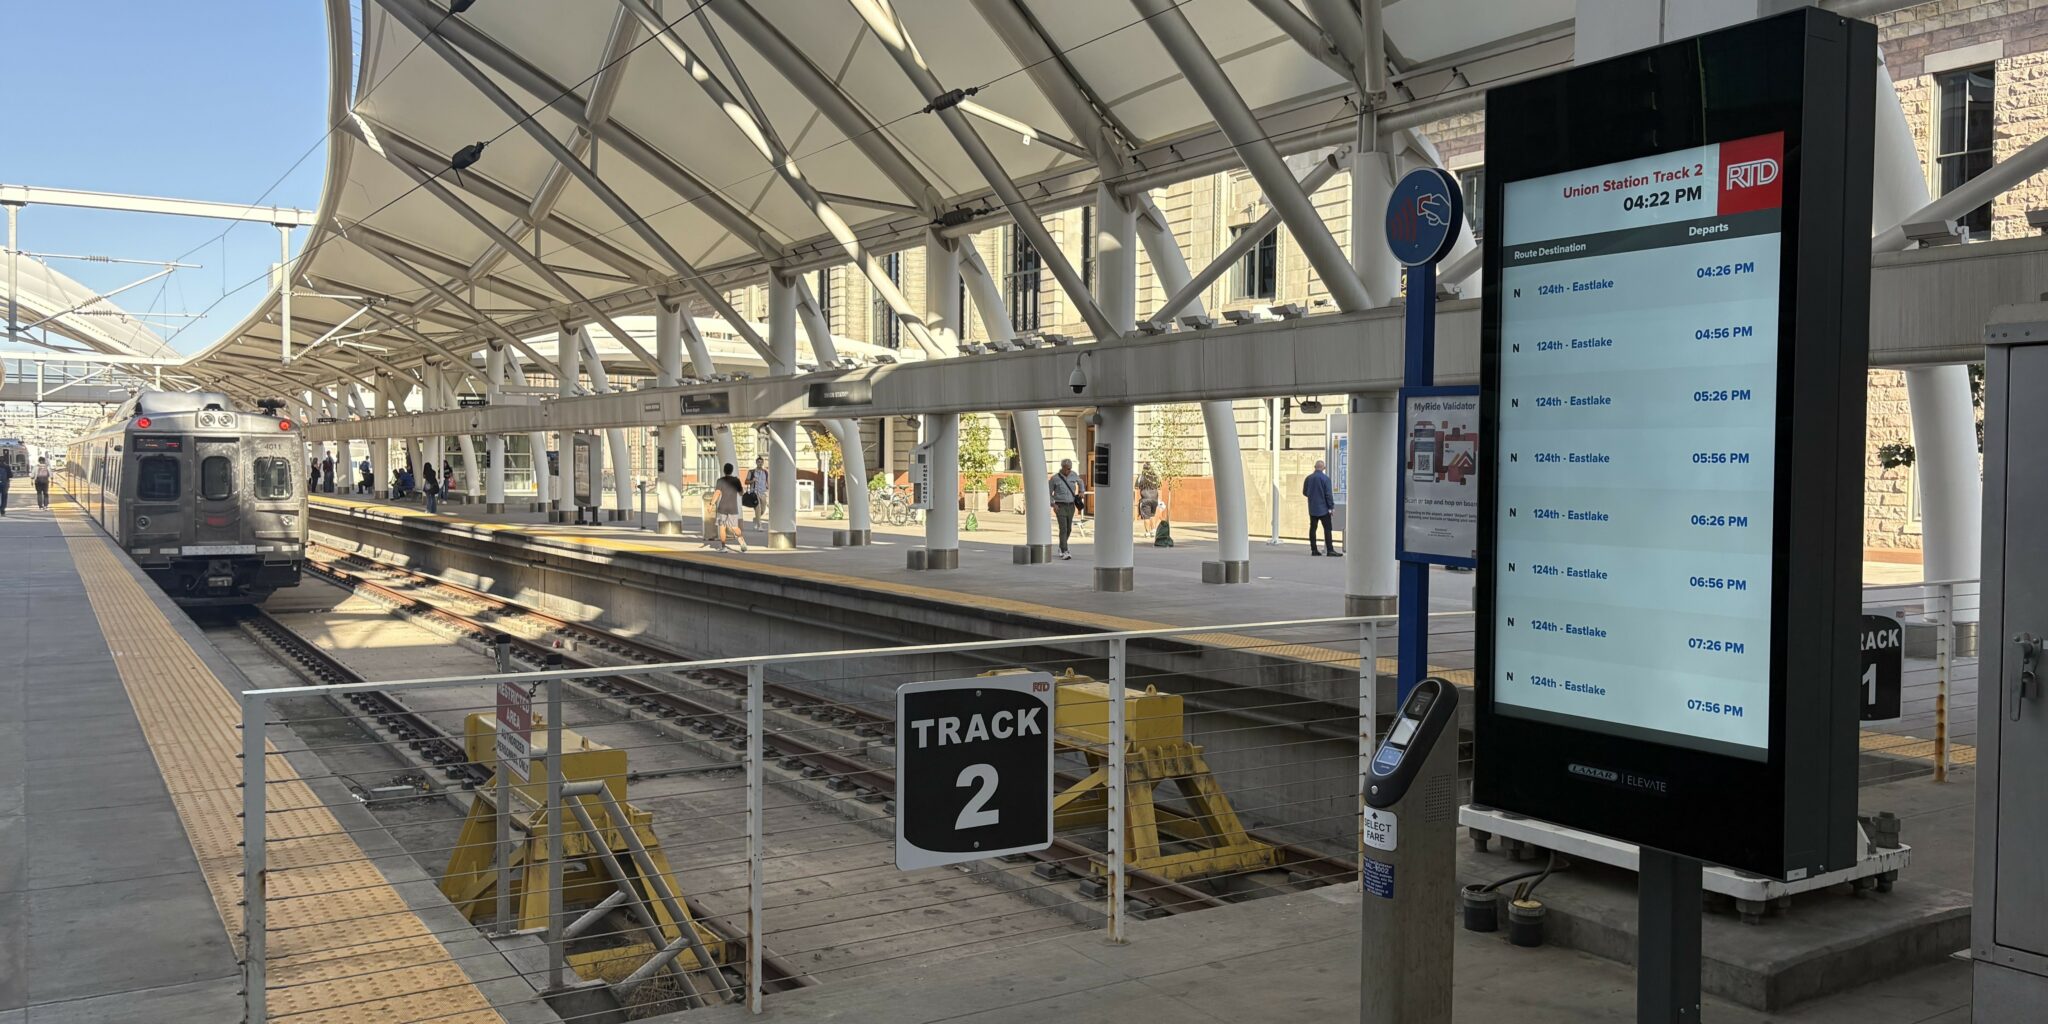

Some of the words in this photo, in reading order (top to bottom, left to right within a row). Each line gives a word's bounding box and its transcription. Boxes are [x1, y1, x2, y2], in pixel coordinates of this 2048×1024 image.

[1563, 183, 1600, 198] Union
[1602, 174, 1649, 192] Station
[1652, 168, 1690, 184] Track
[1694, 164, 1703, 176] 2
[1726, 158, 1778, 190] RTD
[1623, 190, 1670, 212] 04:22
[1674, 185, 1702, 204] PM
[1688, 223, 1728, 238] Departs
[1514, 248, 1537, 260] Route
[1538, 242, 1586, 257] Destination
[1514, 288, 1521, 298] N
[1538, 284, 1564, 296] 124th
[1572, 278, 1614, 292] Eastlake
[1696, 264, 1731, 278] 04:26
[1734, 262, 1754, 275] PM
[1513, 344, 1520, 353] N
[1537, 339, 1563, 351] 124th
[1571, 337, 1613, 350] Eastlake
[1695, 327, 1729, 340] 04:56
[1733, 326, 1753, 338] PM
[1414, 402, 1441, 412] MyRide
[1443, 402, 1476, 411] Validator
[1512, 398, 1518, 408] N
[1536, 396, 1562, 407] 124th
[1570, 395, 1611, 406] Eastlake
[1693, 391, 1728, 402] 05:26
[1731, 390, 1751, 401] PM
[1510, 453, 1518, 462] N
[1534, 453, 1561, 463] 124th
[1568, 453, 1610, 464] Eastlake
[1692, 453, 1726, 464] 05:56
[1730, 453, 1750, 464] PM
[1509, 508, 1516, 517] N
[1533, 508, 1560, 520] 124th
[1568, 510, 1609, 522] Eastlake
[1691, 515, 1725, 526] 06:26
[1728, 516, 1748, 527] PM
[1508, 563, 1515, 572] N
[1532, 564, 1558, 576] 124th
[1567, 567, 1608, 580] Eastlake
[1689, 576, 1724, 589] 06:56
[1727, 579, 1747, 590] PM
[1508, 617, 1514, 626] N
[1531, 620, 1558, 632] 124th
[1565, 624, 1607, 638] Eastlake
[1688, 638, 1722, 652] 07:26
[1725, 642, 1744, 654] PM
[1861, 628, 1899, 650] ACK
[1032, 682, 1050, 693] RTD
[1506, 672, 1513, 681] N
[1530, 675, 1557, 688] 124th
[1565, 680, 1606, 696] Eastlake
[1687, 699, 1721, 713] 07:56
[1724, 704, 1743, 717] PM
[1862, 664, 1876, 705] 1
[911, 707, 1042, 749] TRACK
[1572, 765, 1613, 780] LAMAR
[1627, 775, 1666, 792] ELEVATE
[954, 763, 999, 830] 2
[1365, 818, 1392, 832] SELECT
[1367, 830, 1384, 843] FARE
